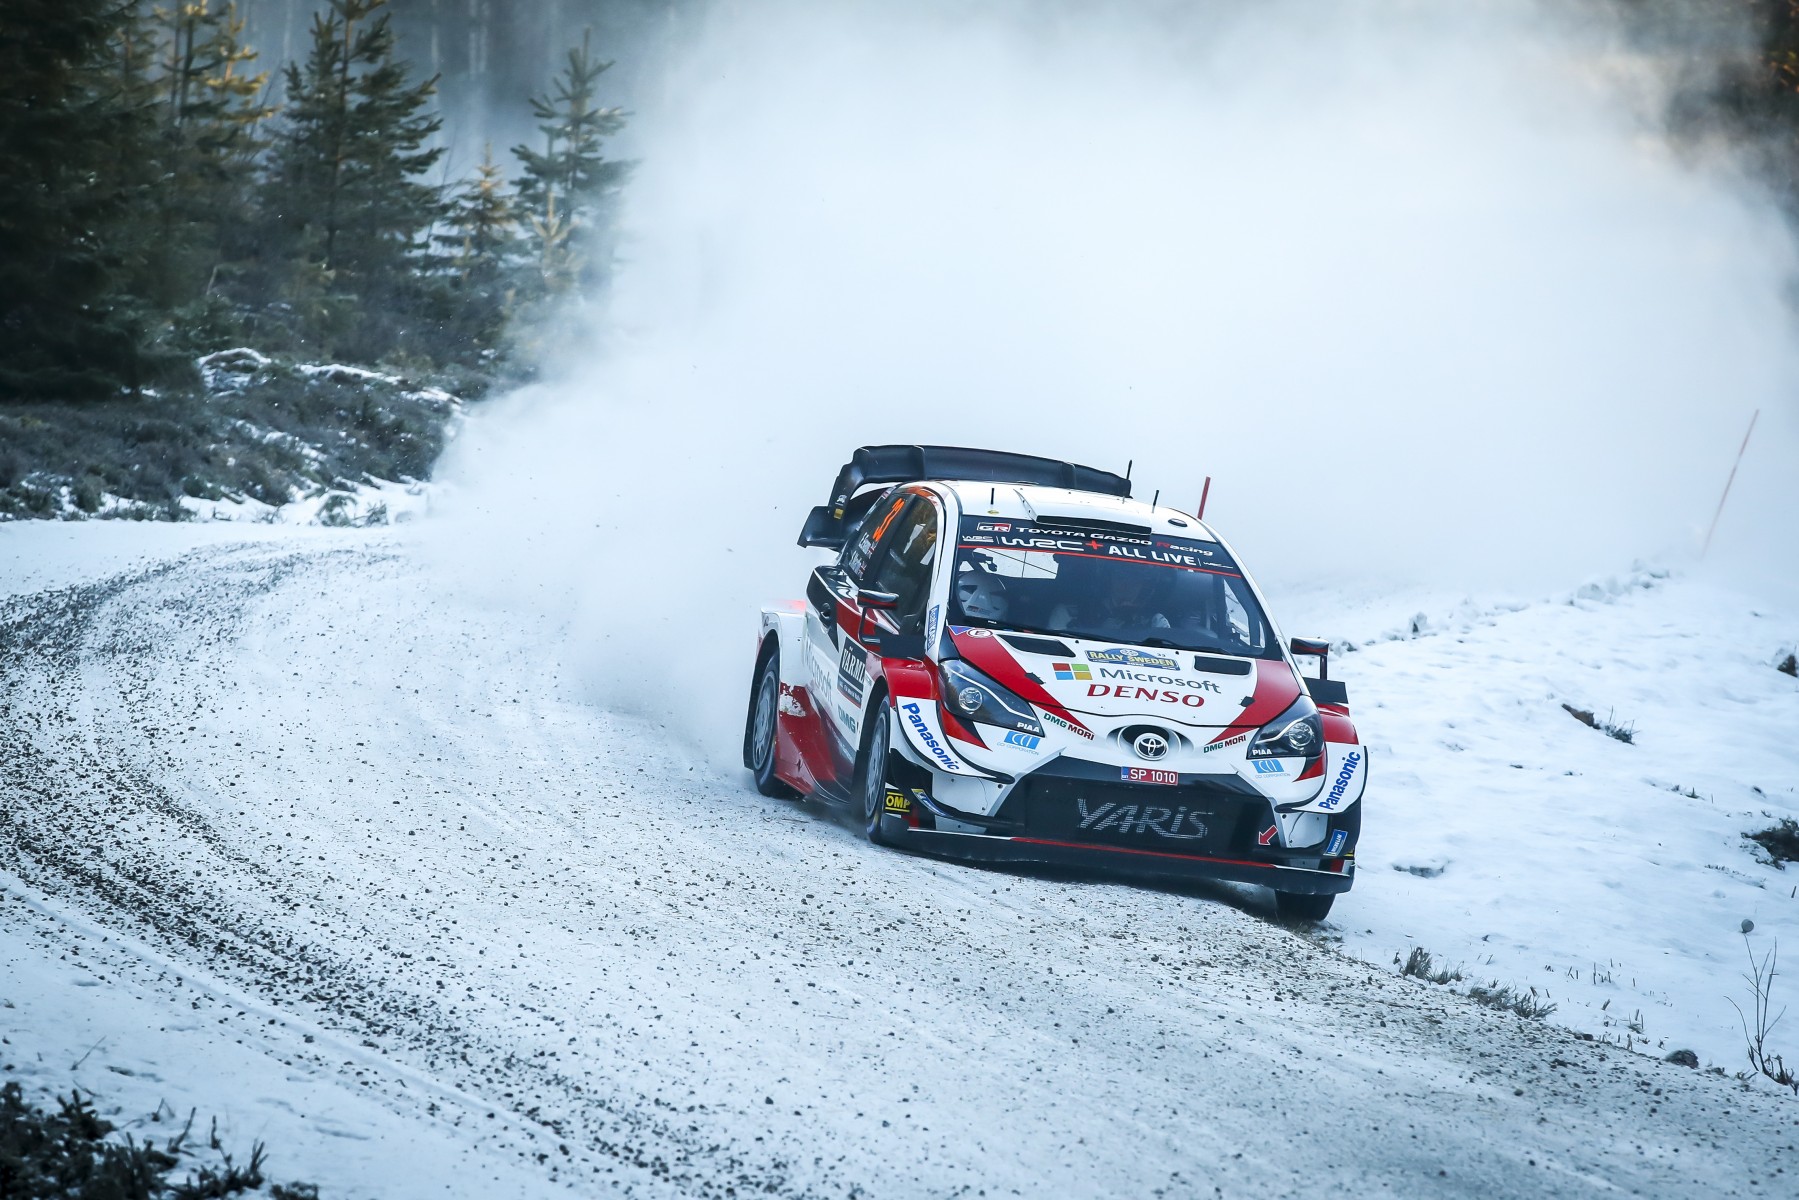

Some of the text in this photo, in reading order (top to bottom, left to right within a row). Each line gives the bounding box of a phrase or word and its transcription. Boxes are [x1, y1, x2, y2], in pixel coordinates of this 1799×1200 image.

[1015, 526, 1086, 538] TOYOTA
[1090, 533, 1153, 546] GAZOO
[1156, 541, 1214, 556] Racing
[1108, 545, 1147, 559] ALL
[1151, 551, 1197, 566] LIVE
[1089, 651, 1123, 661] RALLY
[1128, 656, 1175, 667] SWEDEN
[1100, 668, 1222, 694] Microsoft
[1087, 684, 1205, 708] DENSO
[902, 703, 960, 770] Panasonic
[1017, 722, 1040, 733] PIAA
[1043, 712, 1095, 741] DMG MORI
[1203, 735, 1247, 754] DMG MORI
[1130, 769, 1176, 784] SP 1010
[1318, 751, 1361, 811] Panasonic
[885, 795, 911, 809] OMP
